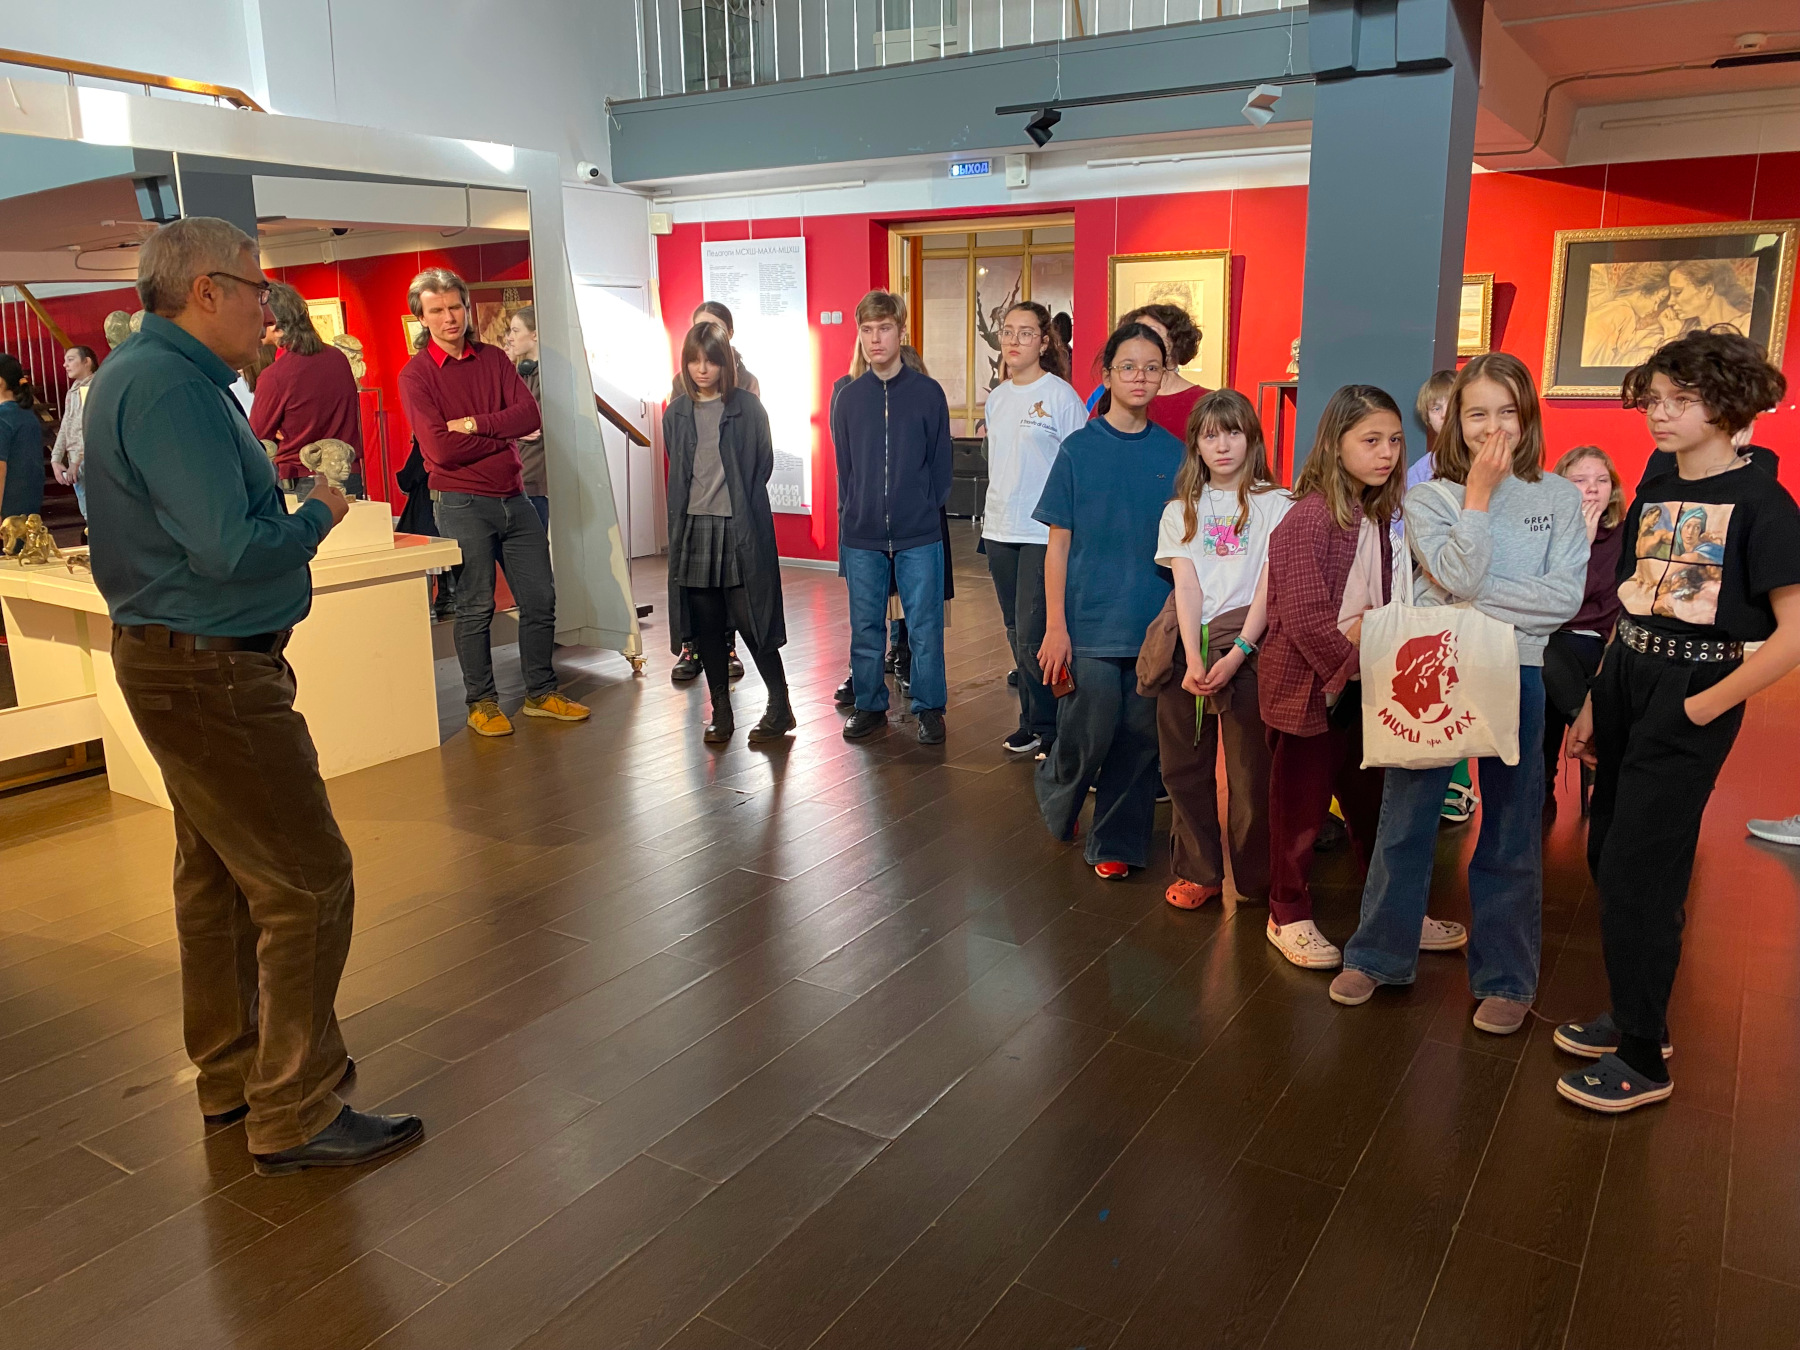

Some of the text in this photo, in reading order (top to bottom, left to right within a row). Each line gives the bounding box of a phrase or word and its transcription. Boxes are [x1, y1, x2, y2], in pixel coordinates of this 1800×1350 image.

[952, 162, 988, 176] ВЫХОД
[1524, 513, 1555, 525] GREAT
[1377, 707, 1421, 744] МЦХШ
[1443, 710, 1477, 741] РАХ
